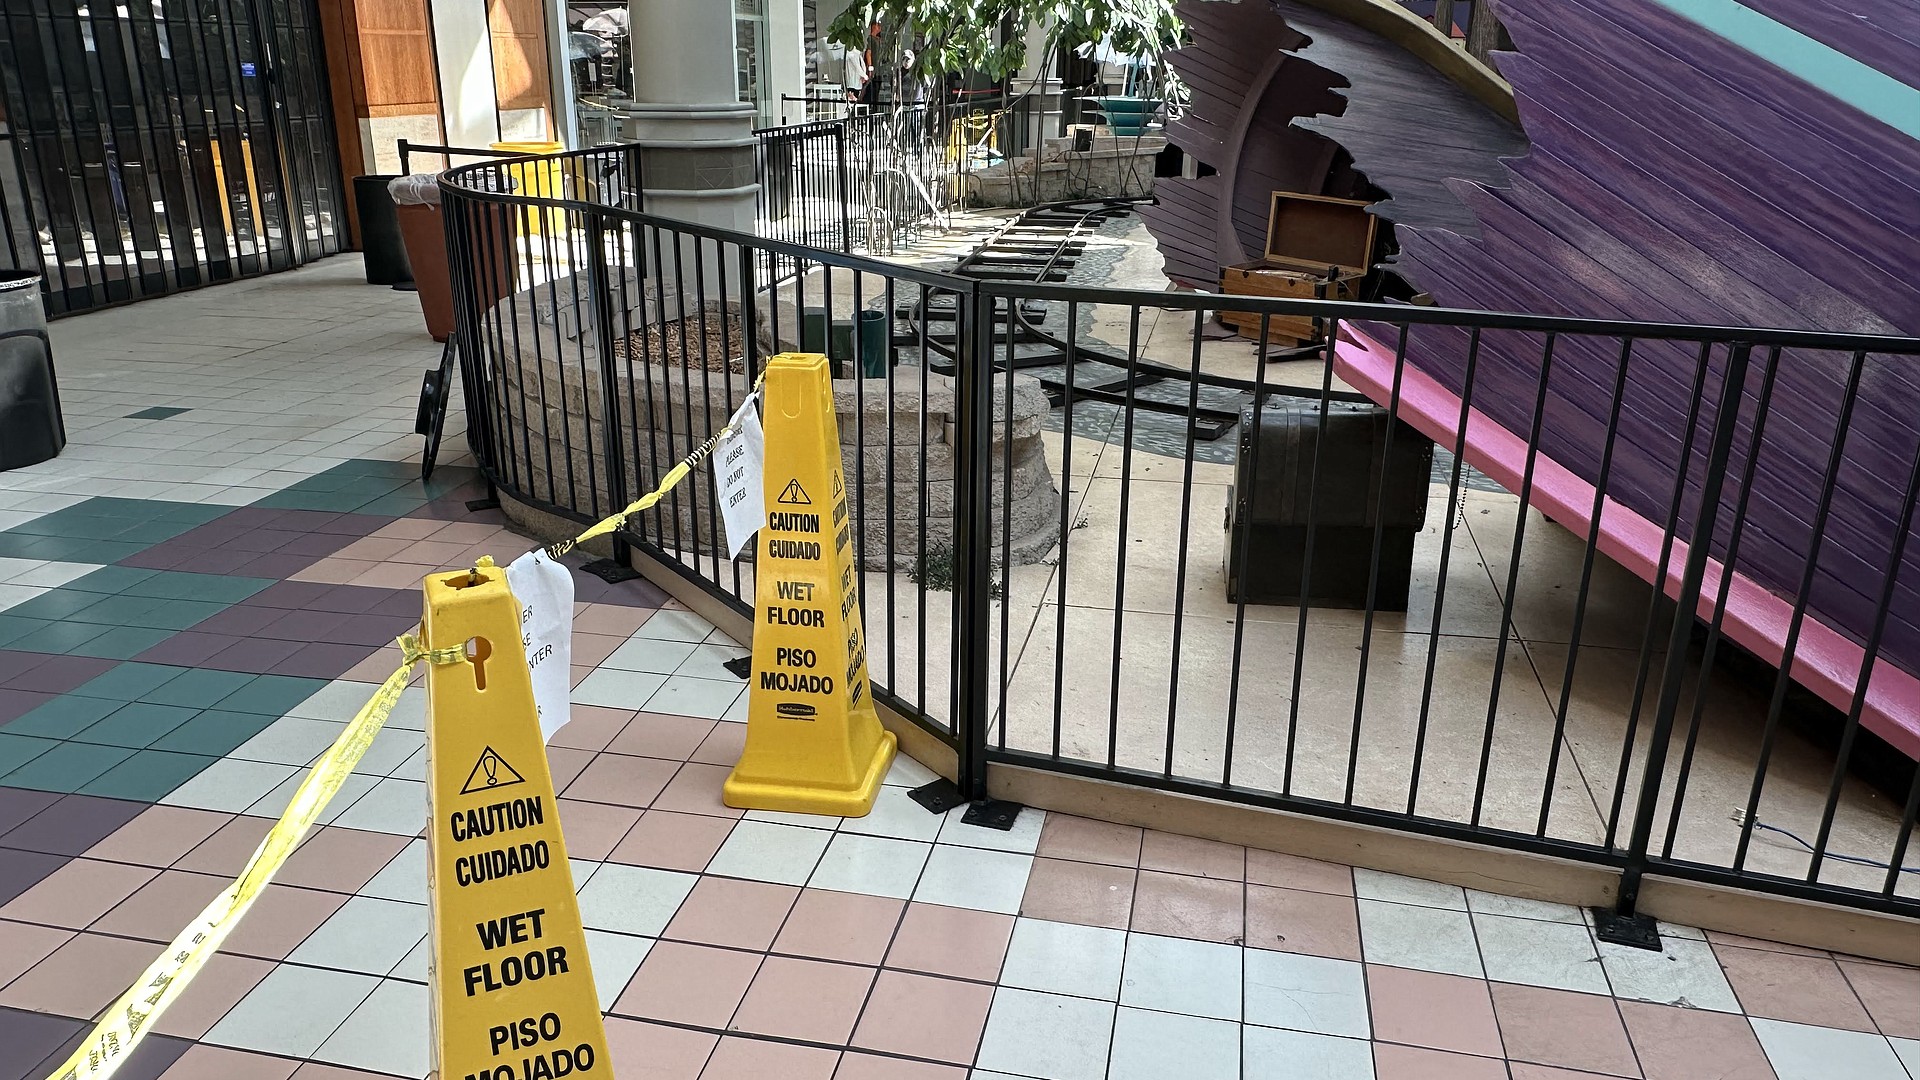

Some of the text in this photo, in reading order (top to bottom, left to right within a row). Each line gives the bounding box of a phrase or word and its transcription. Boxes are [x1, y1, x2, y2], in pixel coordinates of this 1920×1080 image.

[769, 512, 819, 533] CAUTION
[769, 539, 821, 561] CUIDADO
[777, 581, 815, 602] WET
[767, 607, 825, 628] FLOOR
[529, 644, 552, 672] NTER
[776, 648, 817, 668] PISO
[760, 672, 833, 695] MOJADO
[450, 796, 544, 842] CAUTION
[455, 840, 549, 887] CUIDADO
[476, 908, 545, 950] WET
[463, 946, 569, 997] FLOOR
[489, 1012, 561, 1056] PISO
[464, 1043, 595, 1080] OJADO
